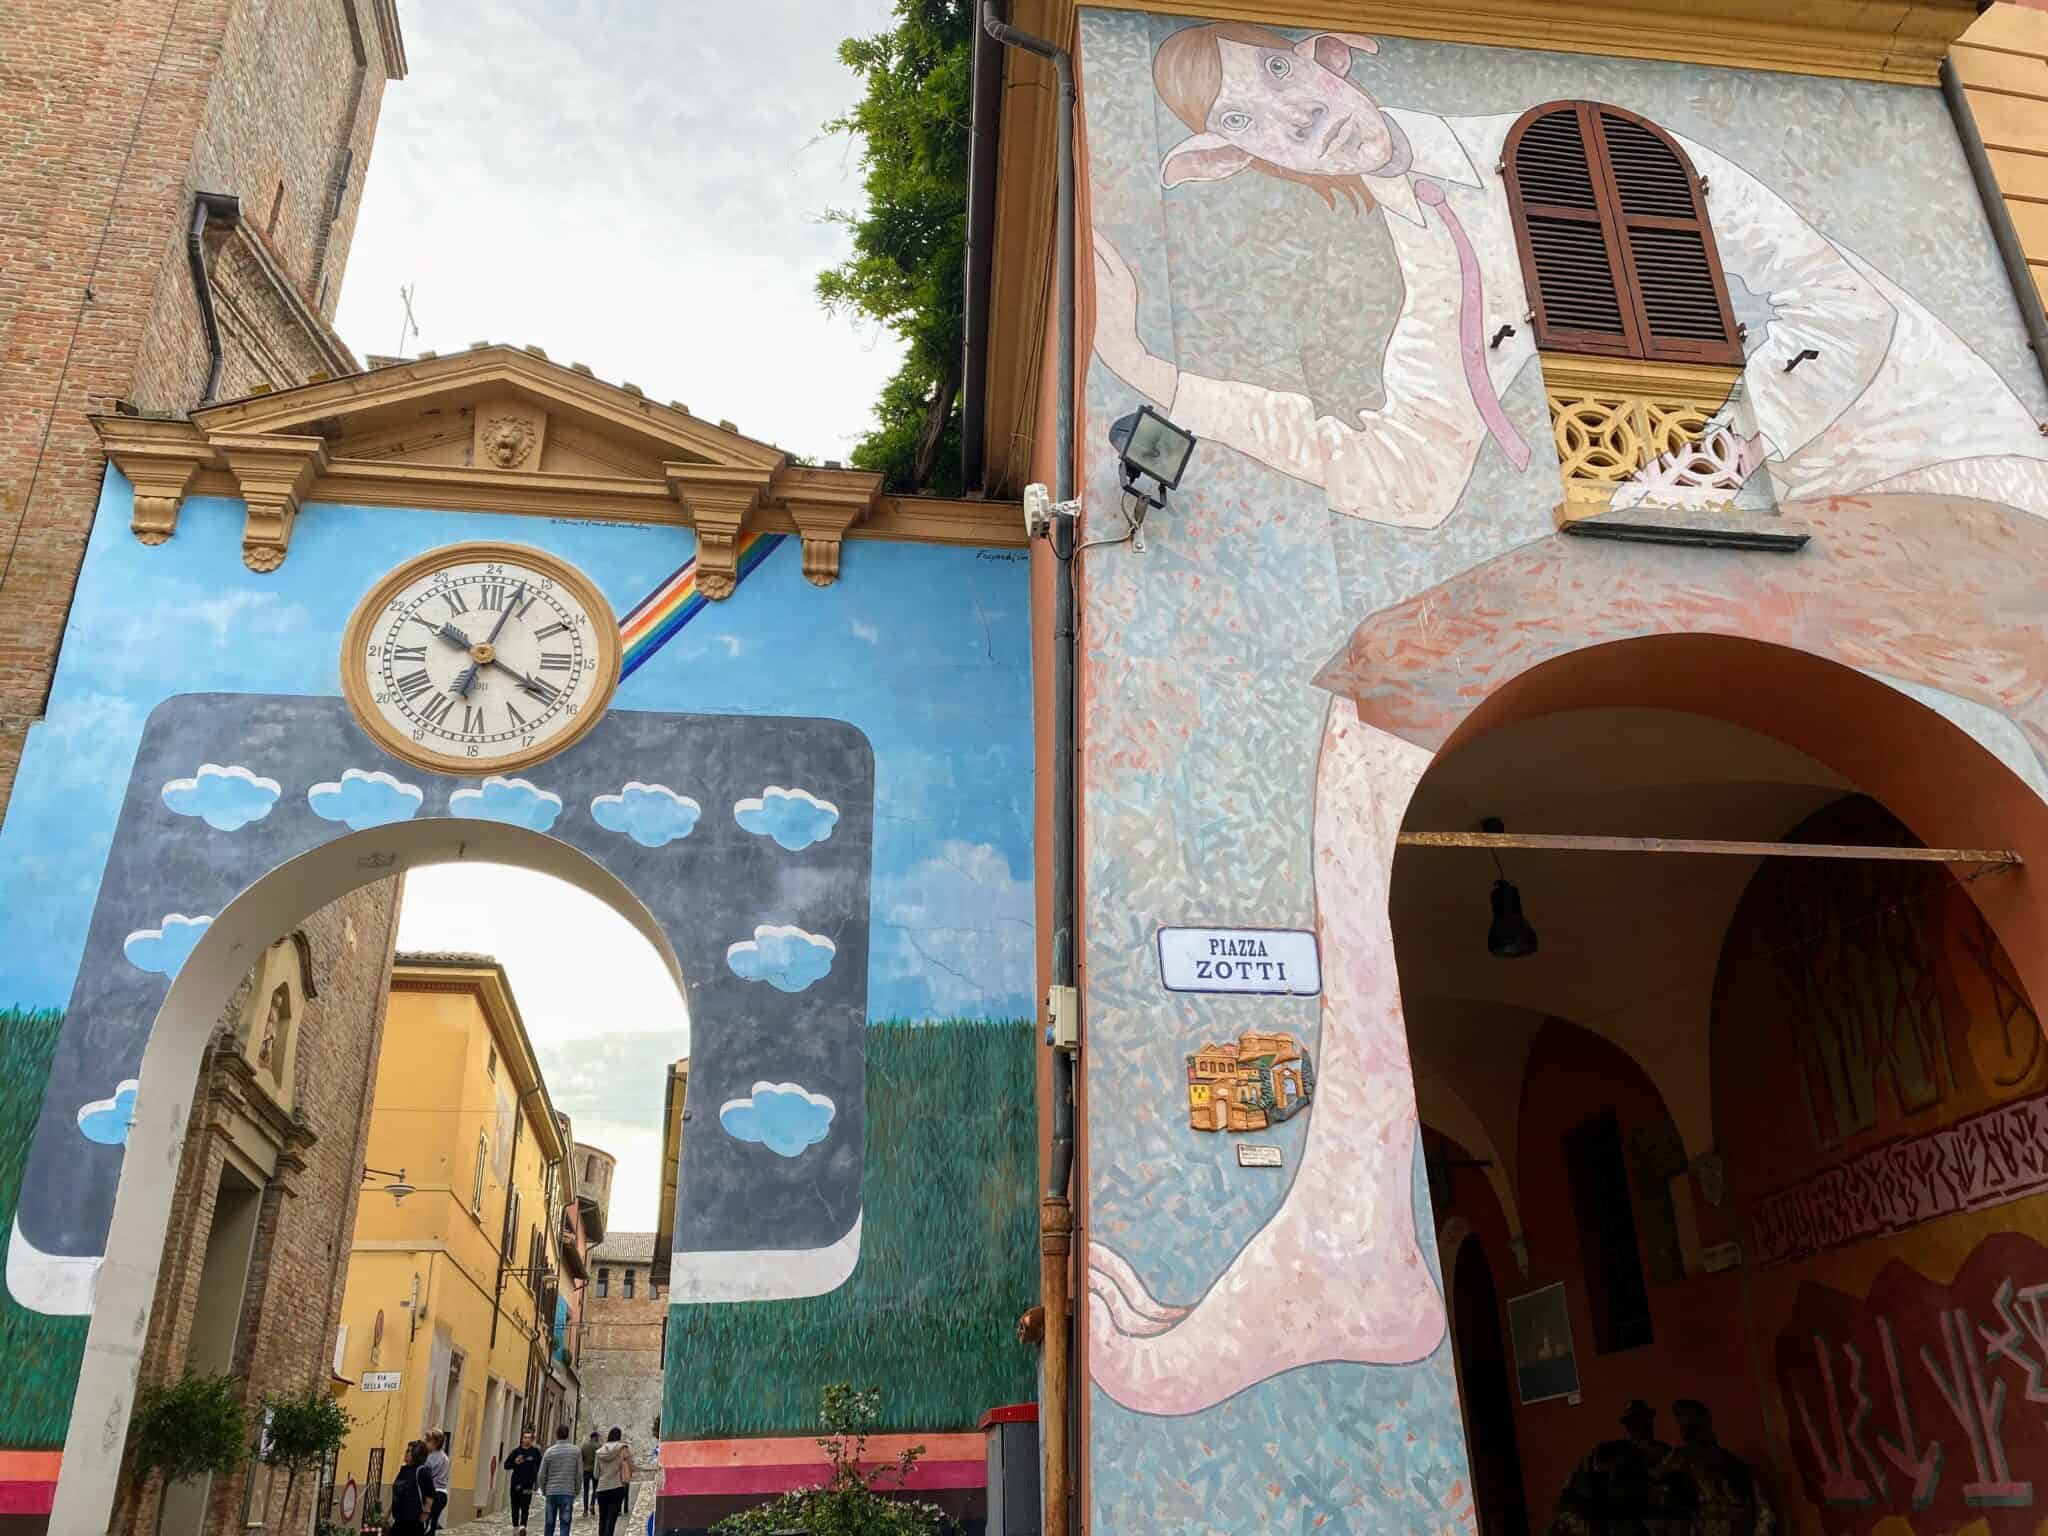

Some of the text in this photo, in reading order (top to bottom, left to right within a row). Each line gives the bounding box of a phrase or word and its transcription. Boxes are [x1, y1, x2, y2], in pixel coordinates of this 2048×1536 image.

[487, 564, 503, 575] 24
[434, 572, 449, 583] 23
[540, 578, 553, 590] 13
[442, 588, 469, 618] XI
[477, 584, 505, 612] XII
[389, 600, 405, 612] 22
[575, 613, 586, 625] 14
[369, 645, 382, 656] 21
[539, 652, 573, 671] III
[583, 658, 596, 670] 15
[376, 692, 390, 704] 20
[565, 703, 578, 716] 16
[412, 729, 424, 741] 19
[521, 735, 535, 748] 17
[466, 745, 479, 758] 18
[1208, 938, 1268, 957] PIAZZA
[1196, 960, 1287, 981] ZOTTI
